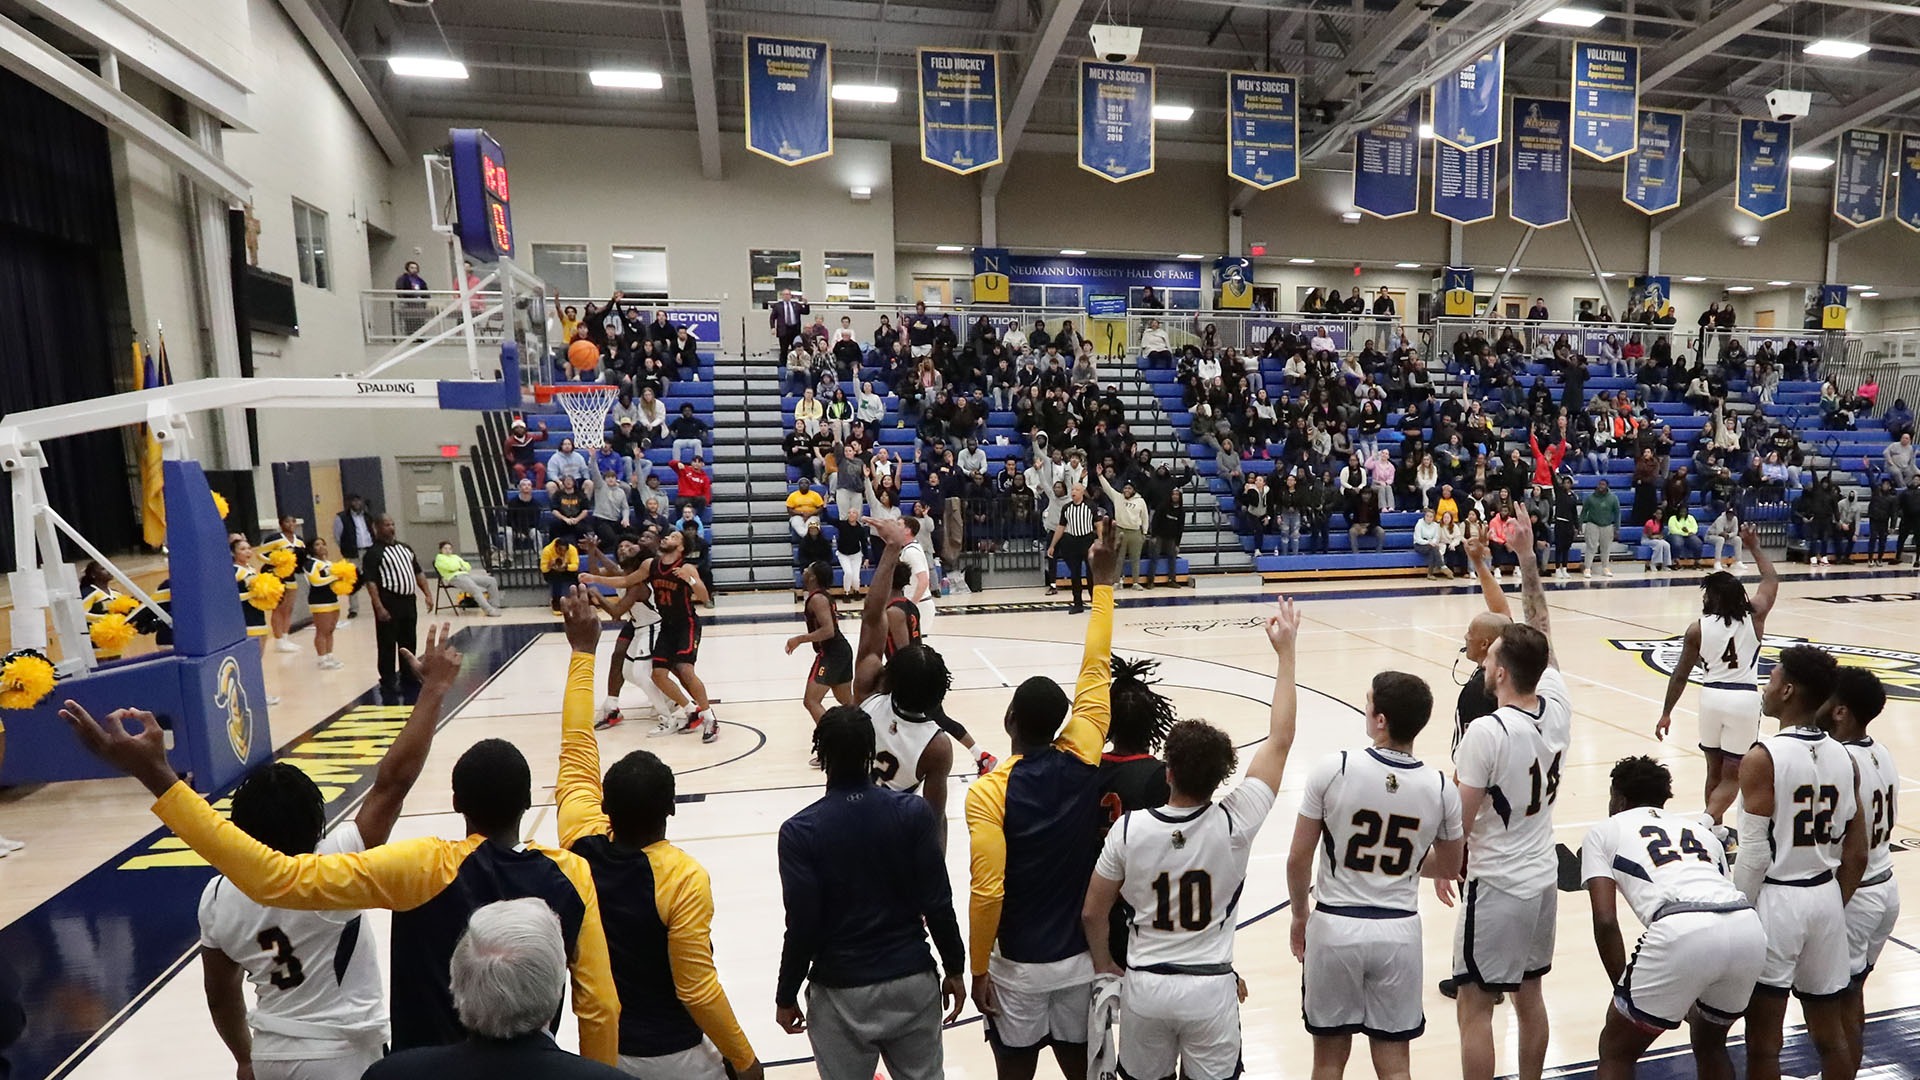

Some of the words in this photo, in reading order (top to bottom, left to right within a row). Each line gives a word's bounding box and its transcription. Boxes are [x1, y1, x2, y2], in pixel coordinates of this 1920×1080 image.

[757, 43, 781, 57] FIELD
[783, 45, 817, 60] HOCKEY
[1586, 48, 1627, 63] VOLLEYBALL
[930, 56, 953, 69] FIELD
[954, 58, 986, 71] HOCKEY
[1089, 67, 1114, 81] MEN'S
[1115, 70, 1145, 84] SOCCER
[1237, 79, 1261, 92] MEN'S
[1262, 81, 1290, 94] SOCCER
[984, 256, 999, 271] N
[1010, 265, 1064, 276] NEUMANN
[1066, 266, 1125, 278] UNIVERSITY
[1126, 268, 1152, 278] HALL
[1153, 270, 1167, 279] OF
[1168, 270, 1194, 280] FAME
[985, 276, 999, 290] U
[1453, 274, 1466, 288] N
[1454, 291, 1465, 305] U
[1831, 291, 1841, 304] N
[667, 313, 718, 322] ECTION
[968, 316, 1019, 325] STION
[1830, 307, 1840, 319] U
[357, 382, 416, 394] SPALDING
[1721, 636, 1739, 669] 4
[1525, 749, 1562, 817] 14
[1792, 784, 1840, 847] 22
[1870, 783, 1895, 850] 21
[1344, 808, 1420, 876] 25
[1639, 825, 1713, 868] 24
[1151, 869, 1213, 932] 10
[257, 926, 305, 990] 3
